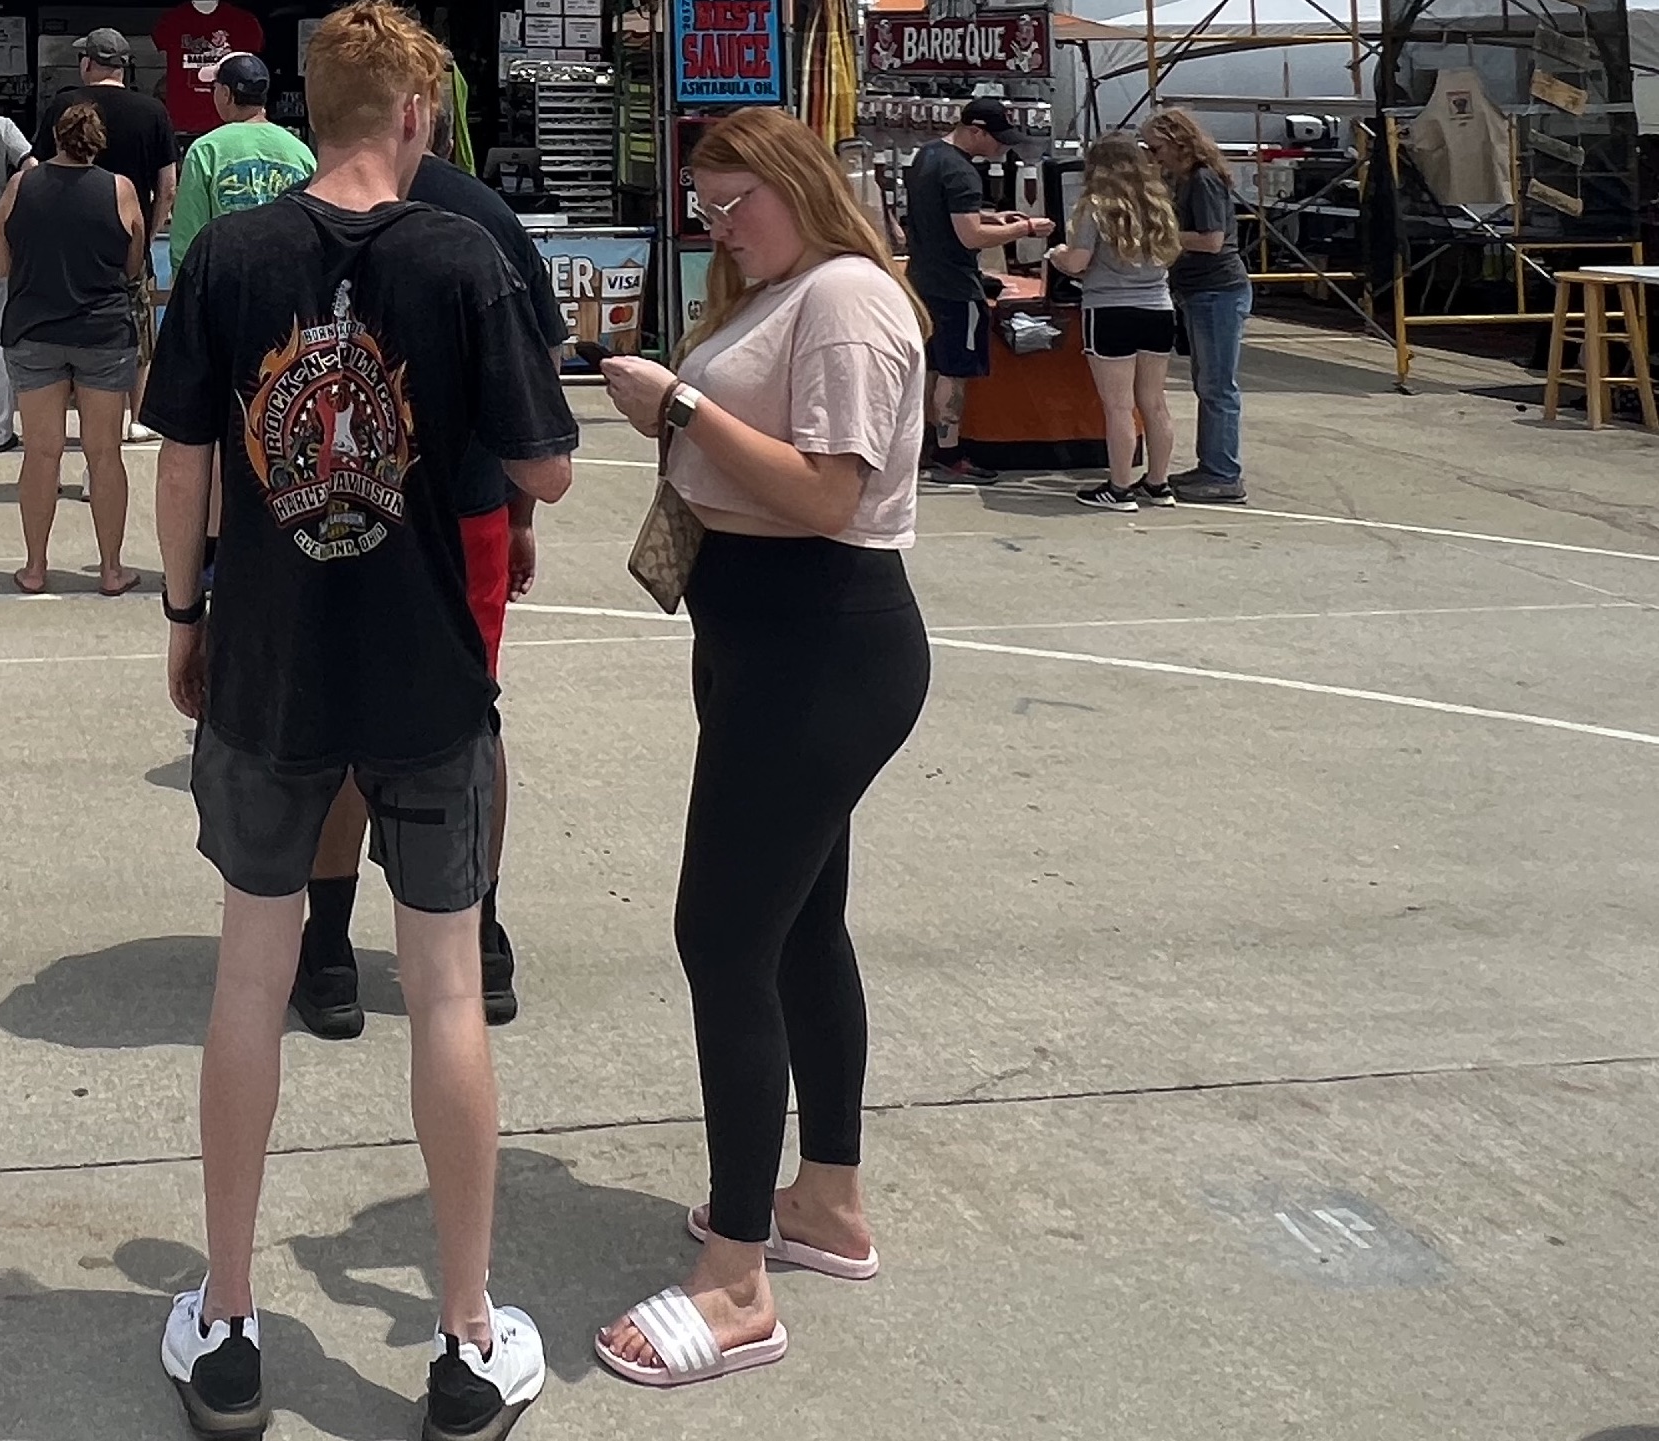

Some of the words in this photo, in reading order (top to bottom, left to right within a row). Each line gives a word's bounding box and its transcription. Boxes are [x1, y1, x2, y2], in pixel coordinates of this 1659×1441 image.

[681, 32, 772, 79] SAUCE
[902, 22, 1008, 68] BARBEQUE
[680, 81, 752, 96] ASHTABULA
[607, 275, 640, 290] VISA
